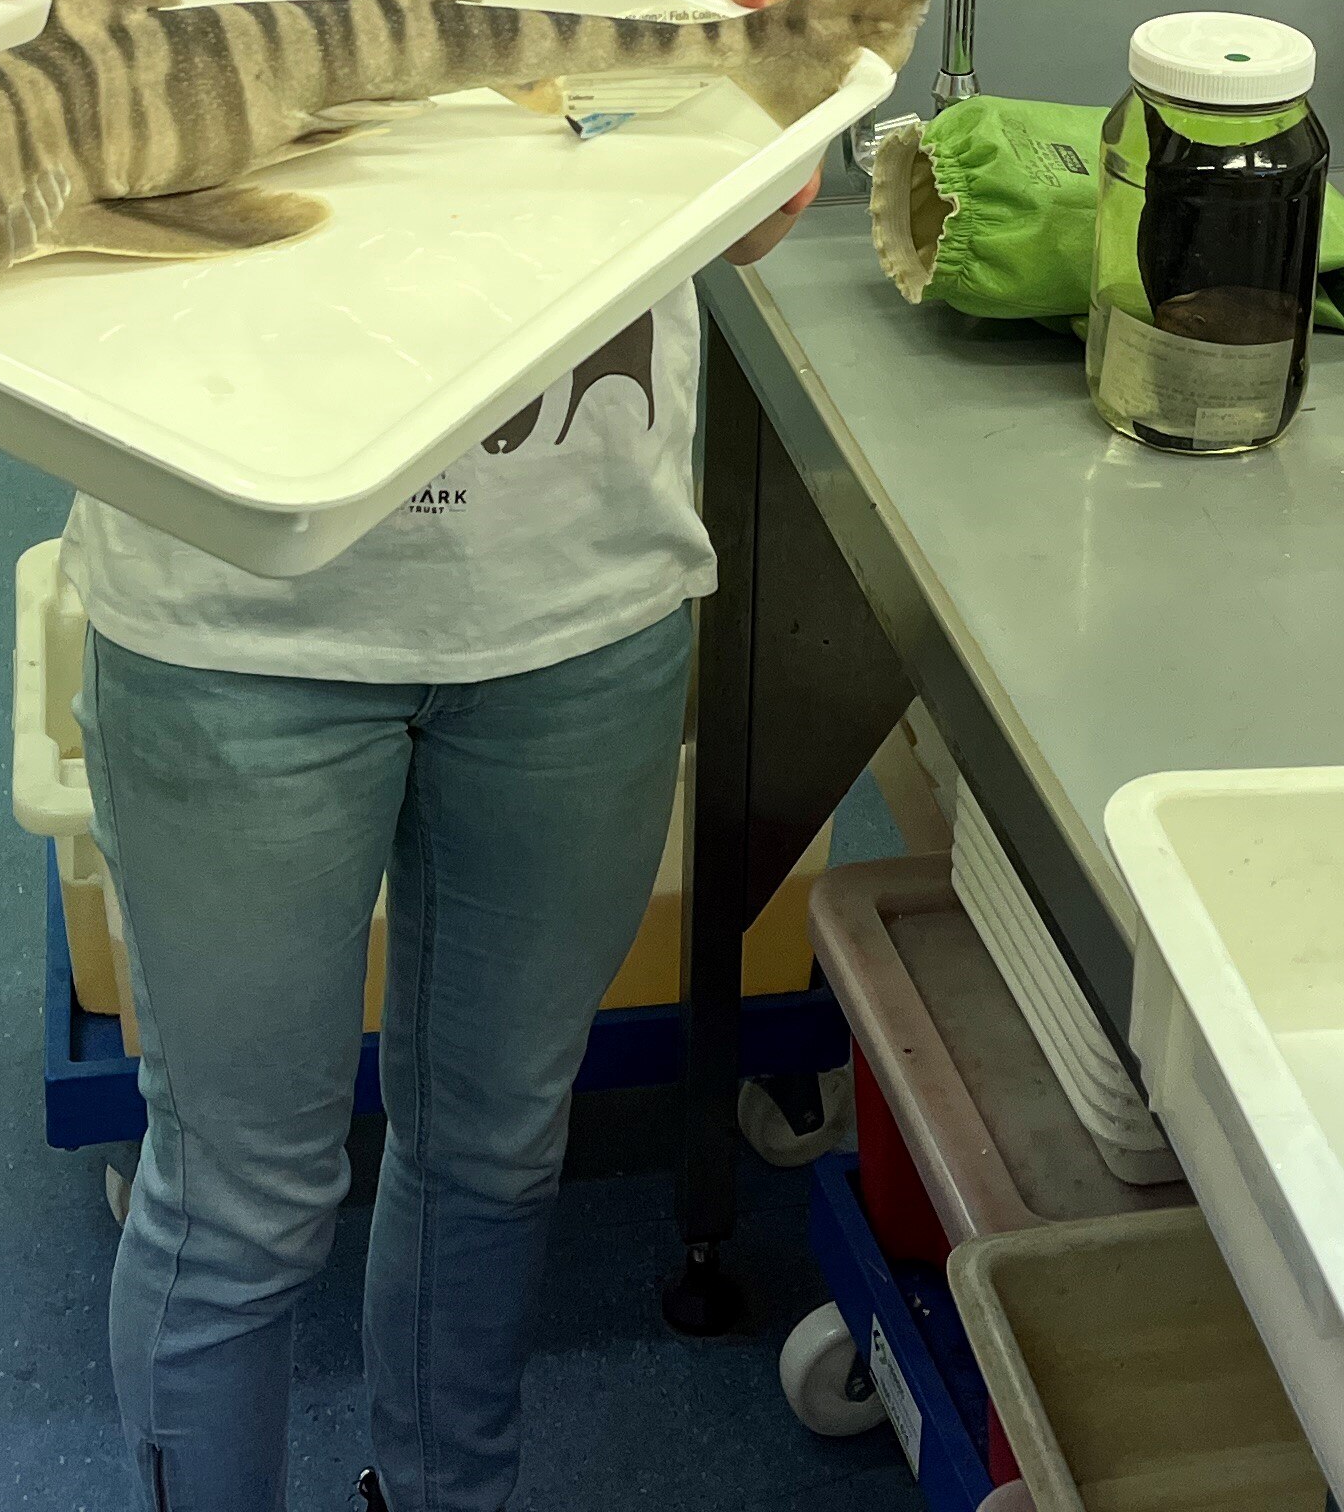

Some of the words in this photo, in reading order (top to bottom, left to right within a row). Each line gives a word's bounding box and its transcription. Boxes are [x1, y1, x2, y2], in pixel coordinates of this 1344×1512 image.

[670, 10, 690, 21] Fish
[411, 489, 468, 504] ARK
[408, 505, 445, 514] TRUST
